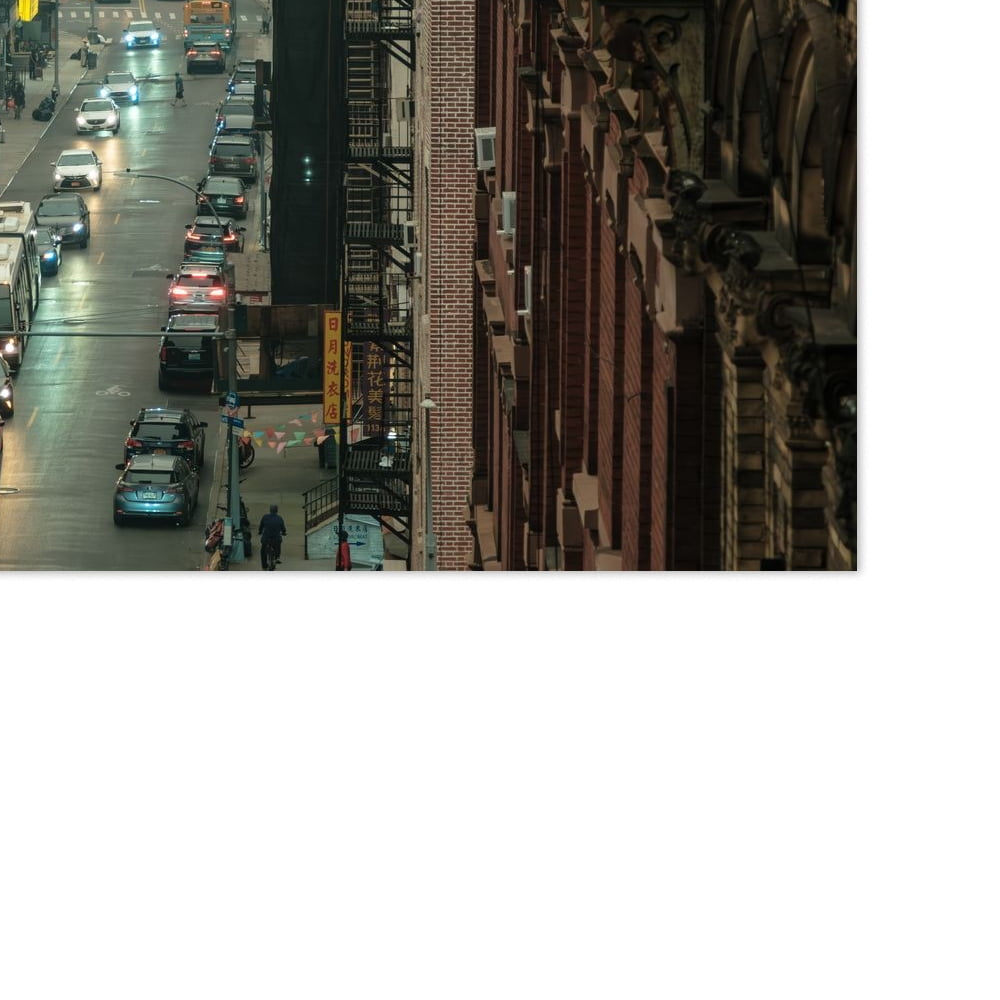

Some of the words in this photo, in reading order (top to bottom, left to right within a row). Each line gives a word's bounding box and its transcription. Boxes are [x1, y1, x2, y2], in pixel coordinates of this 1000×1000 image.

[326, 316, 340, 420] 日月洗衣店
